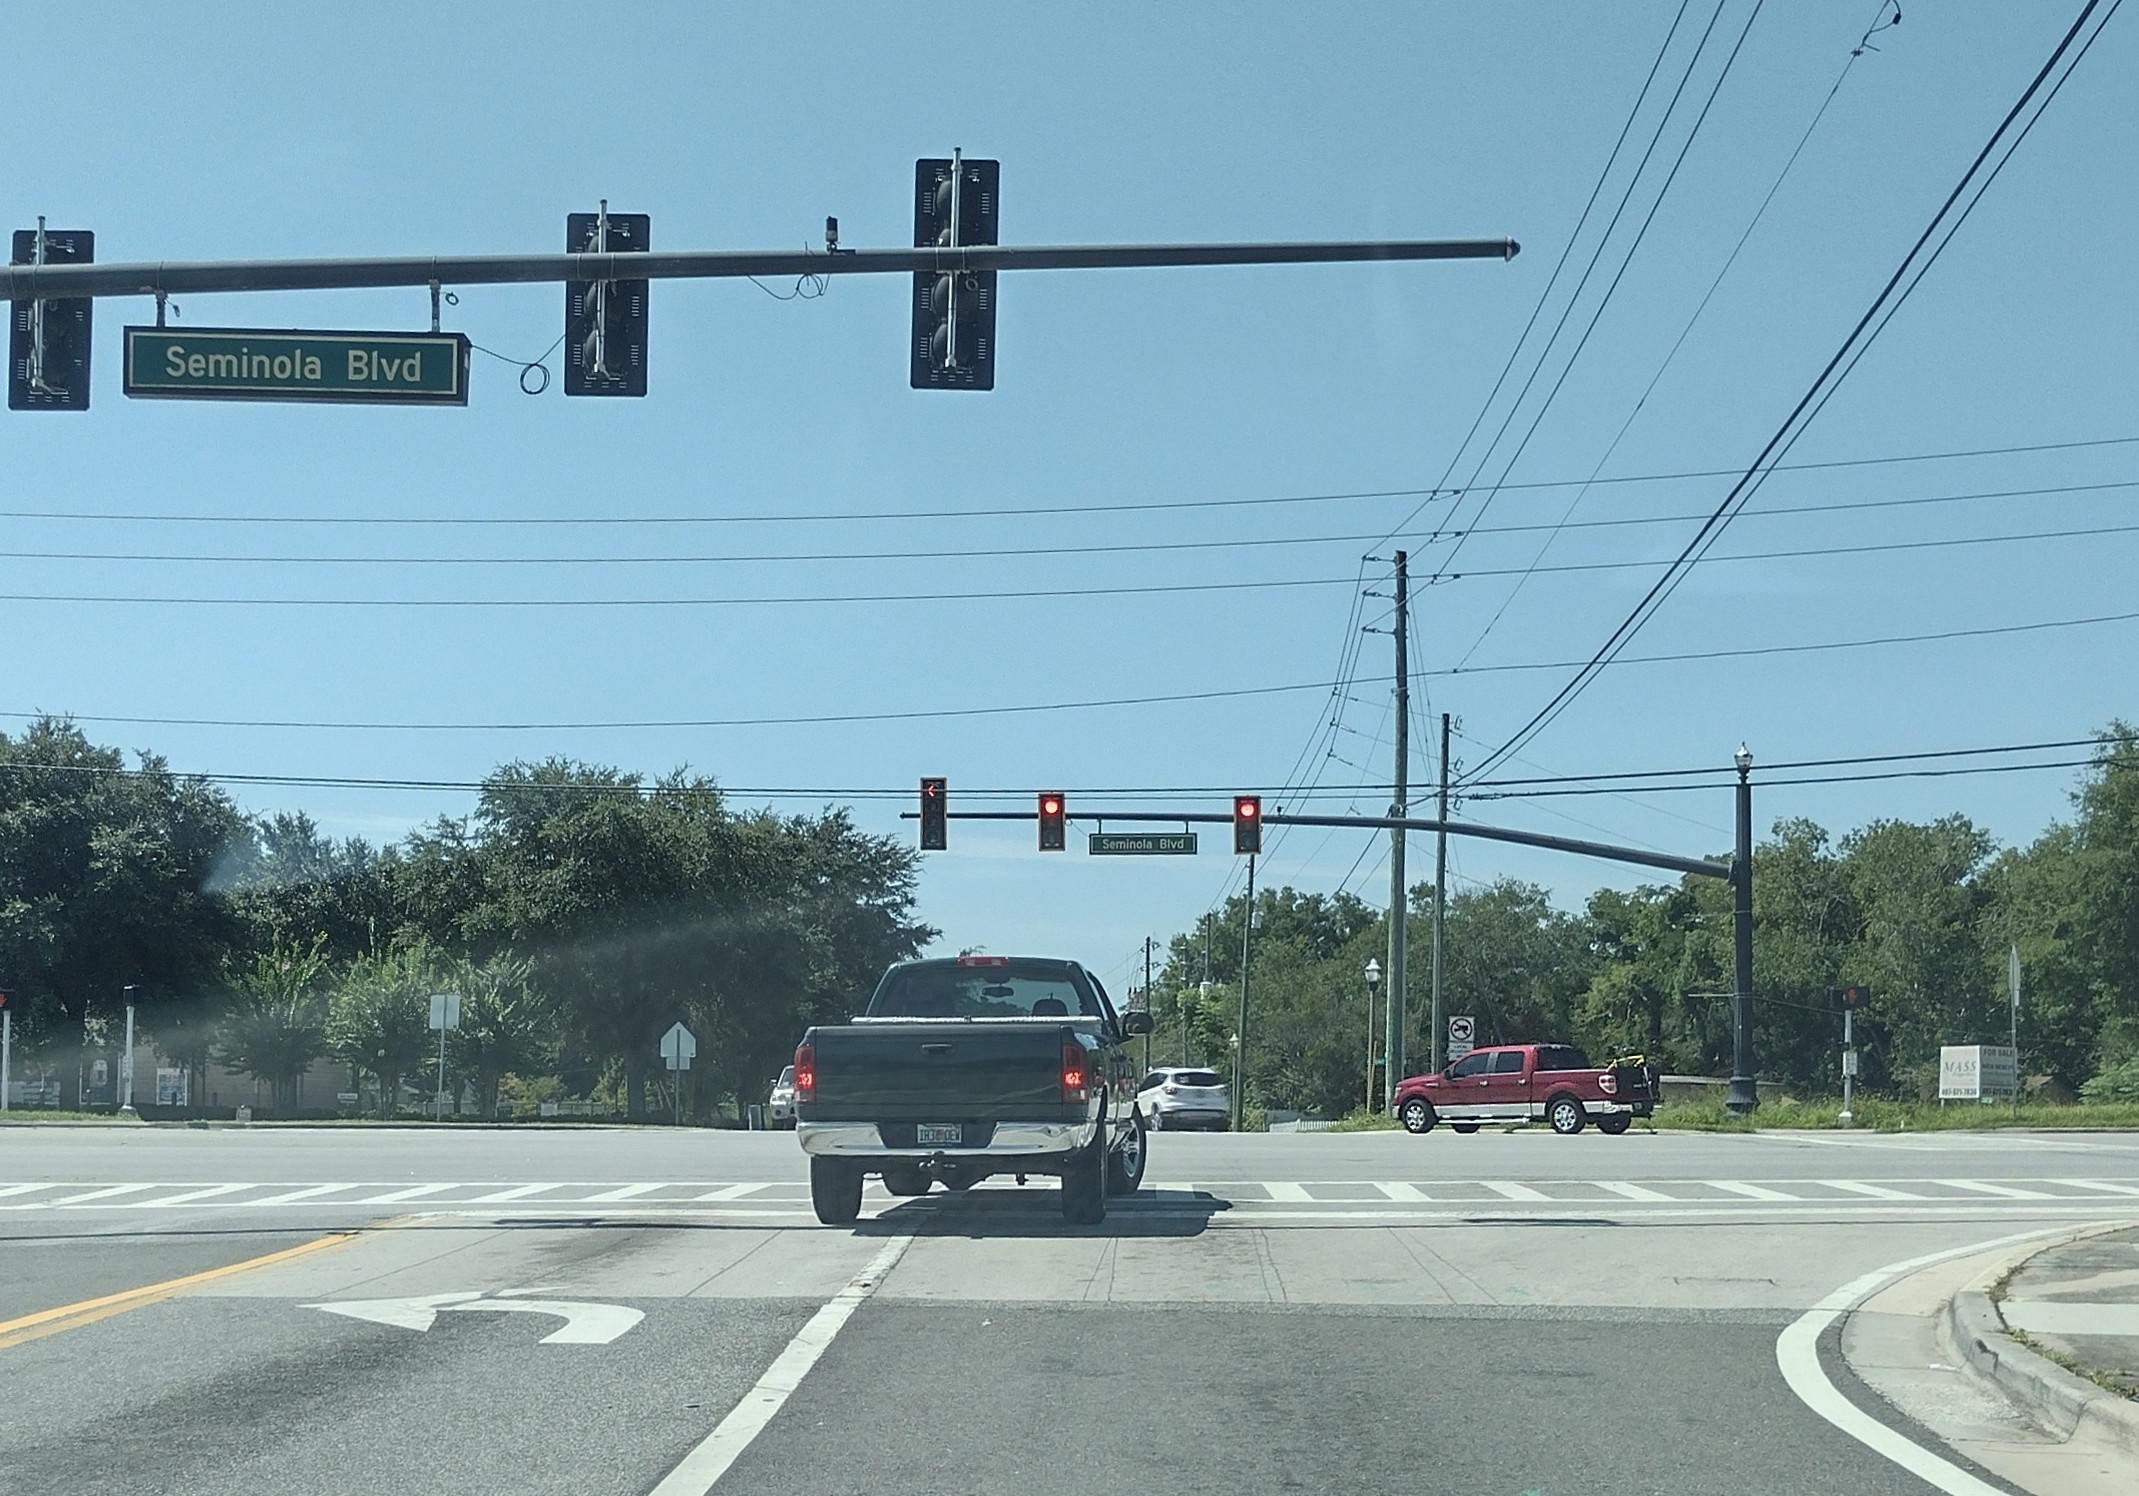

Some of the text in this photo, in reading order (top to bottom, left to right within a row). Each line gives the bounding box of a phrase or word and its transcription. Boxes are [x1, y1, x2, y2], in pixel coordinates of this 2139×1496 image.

[165, 346, 422, 382] Seminola Blvd
[1102, 838, 1184, 850] Seminola Blvd
[1942, 1060, 1977, 1073] MASS
